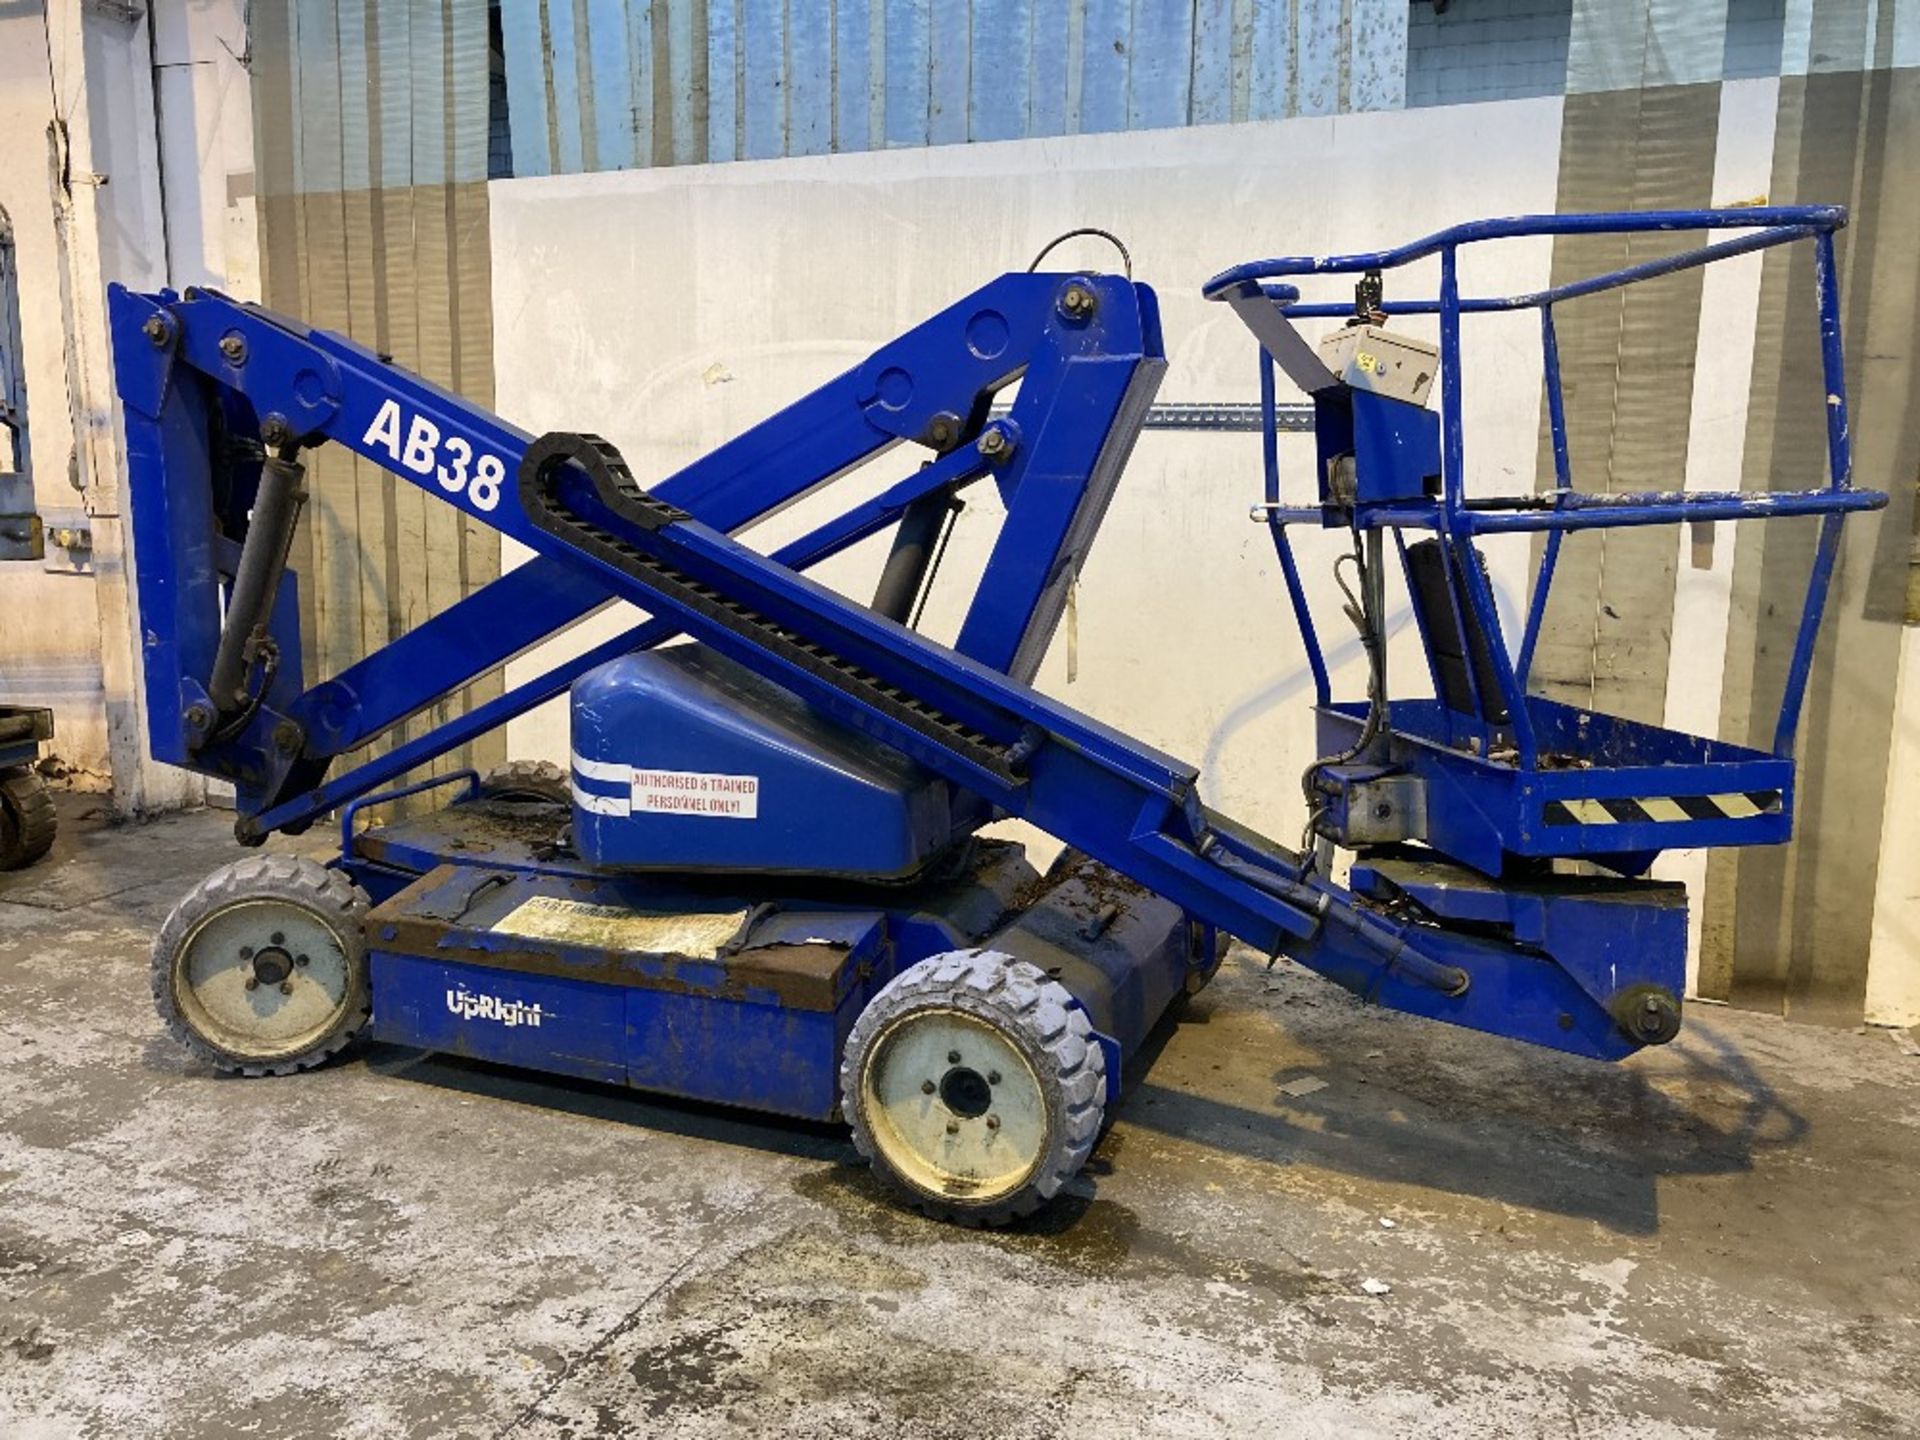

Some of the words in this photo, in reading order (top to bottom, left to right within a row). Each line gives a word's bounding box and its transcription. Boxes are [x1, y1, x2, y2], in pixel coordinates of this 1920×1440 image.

[362, 398, 506, 512] AB38
[633, 773, 698, 791] AUTHORISED
[700, 777, 707, 791] &
[710, 778, 756, 794] TRAINED
[646, 794, 708, 811] PERSONNEL
